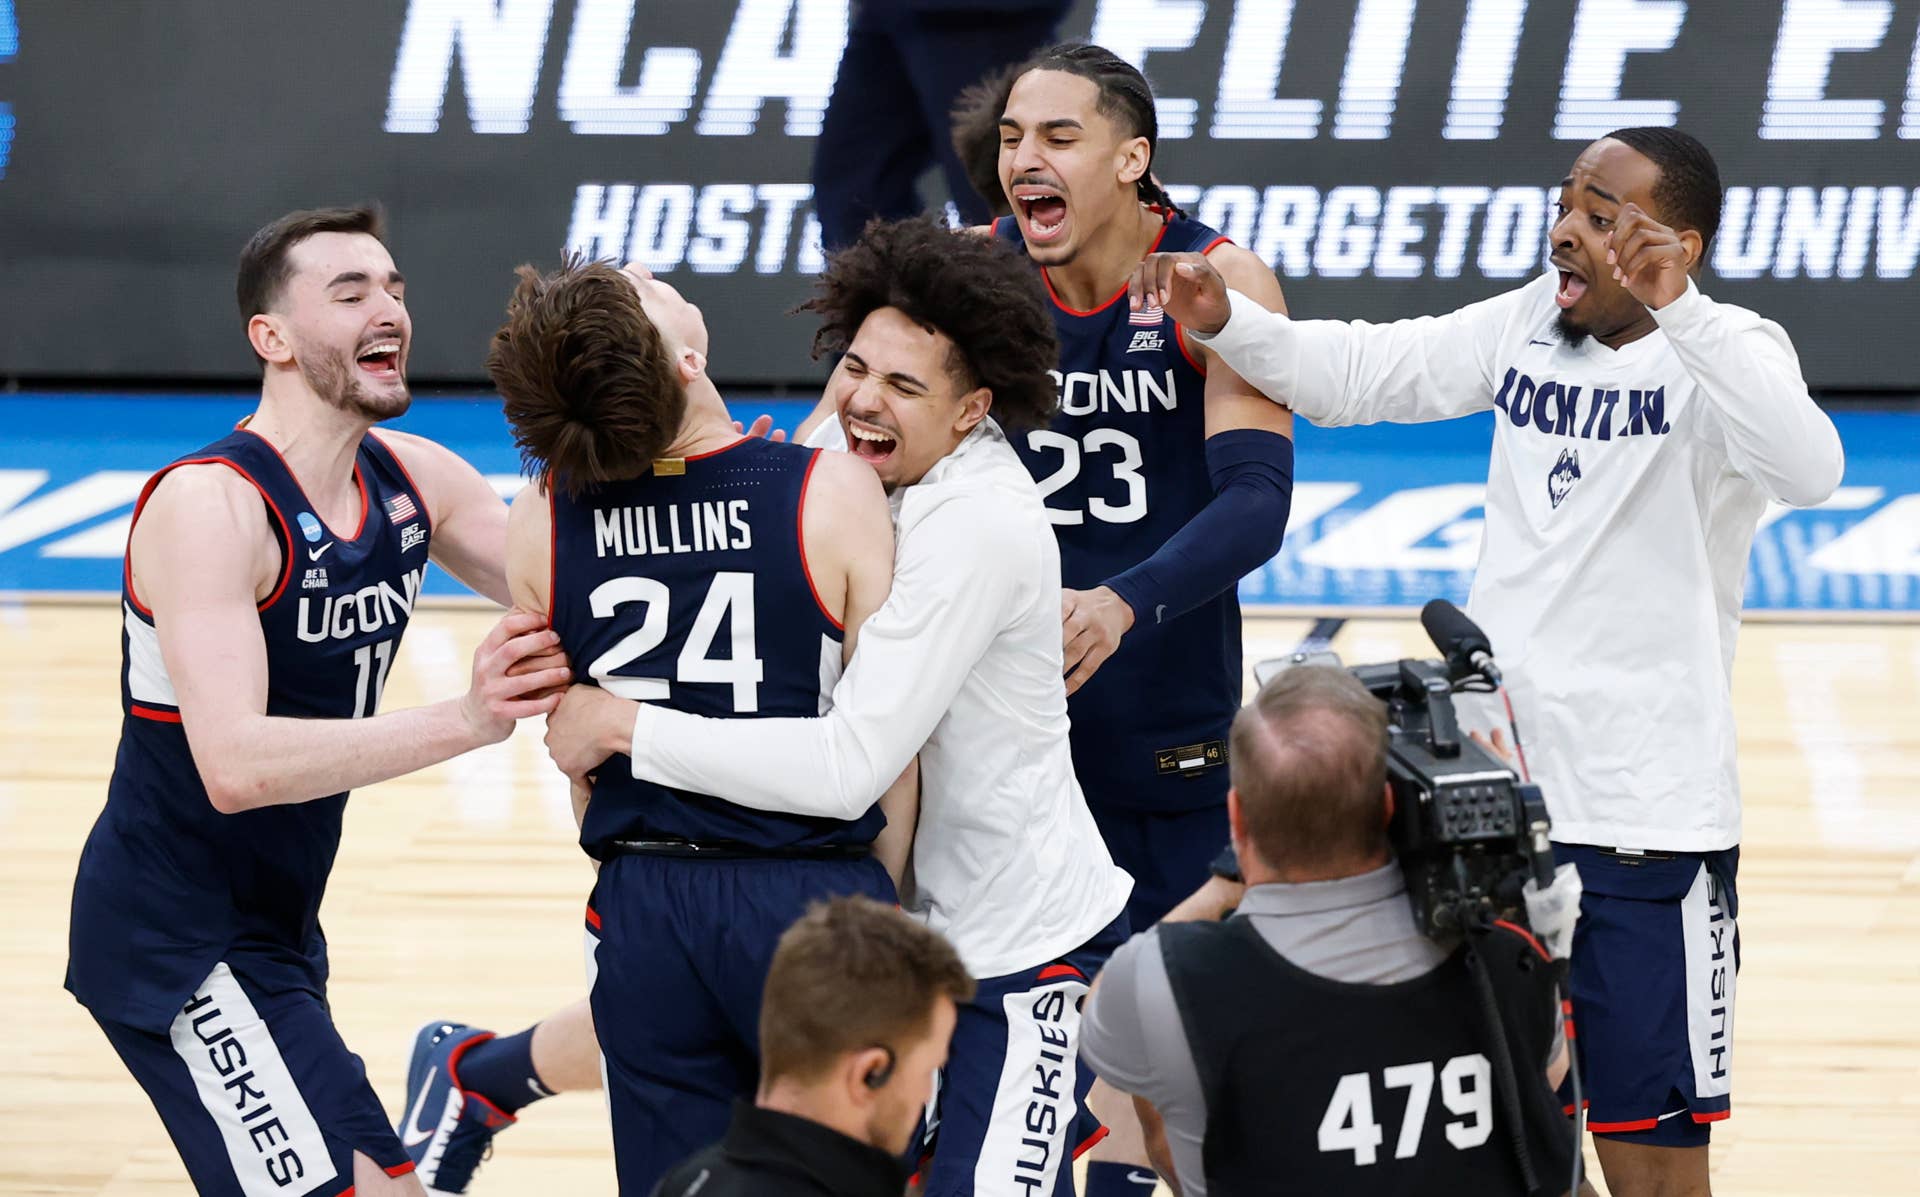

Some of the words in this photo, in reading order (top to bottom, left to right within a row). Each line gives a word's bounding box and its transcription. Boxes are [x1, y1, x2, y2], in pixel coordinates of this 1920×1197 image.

[1757, 0, 1920, 140] E
[1128, 339, 1166, 349] EAST
[1133, 330, 1160, 340] BIG
[1494, 366, 1582, 438] LOCK
[1580, 388, 1620, 441] IT
[1027, 427, 1148, 525] 23
[401, 522, 419, 539] BIG
[401, 529, 427, 548] EAST
[593, 499, 752, 558] MULLINS
[305, 568, 318, 579] BE
[588, 571, 764, 713] 24
[352, 638, 393, 719] 11
[1206, 747, 1219, 759] 46
[1705, 860, 1727, 1080] HUSKIE
[1317, 1052, 1494, 1167] 479
